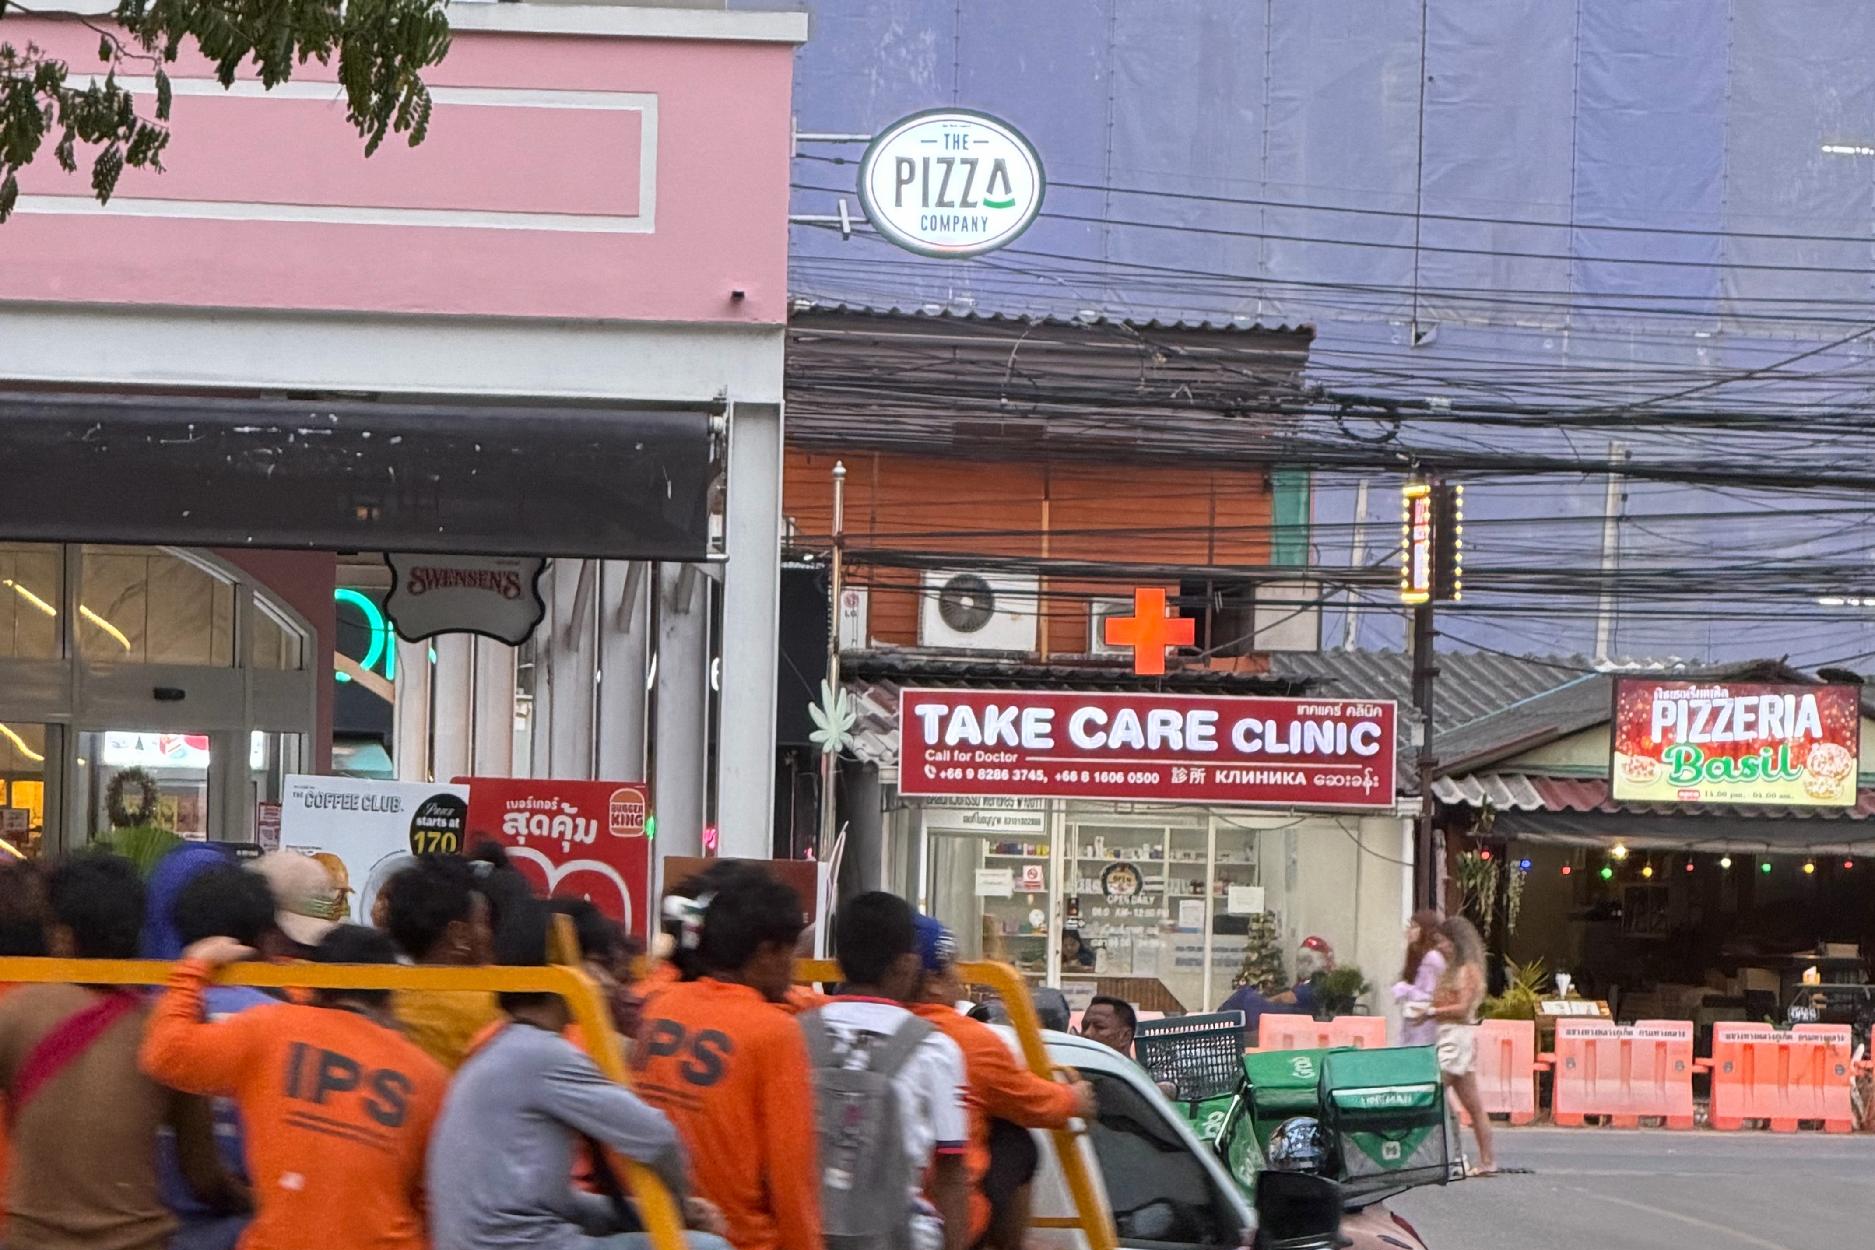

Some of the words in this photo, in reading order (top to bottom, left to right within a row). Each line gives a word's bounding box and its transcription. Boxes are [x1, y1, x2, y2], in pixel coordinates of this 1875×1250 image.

[943, 133, 970, 150] THE
[894, 155, 1016, 209] PIZZA
[920, 214, 988, 232] COMPANY
[406, 566, 521, 600] SWENSEN'S
[1297, 702, 1343, 716] เทคแคร์
[1346, 703, 1383, 718] คลินิก
[1651, 694, 1823, 744] PIZZERIA
[914, 704, 1055, 748] TAKE
[1068, 706, 1219, 751] CARE
[1231, 718, 1382, 756] CLINIC
[924, 749, 951, 762] Call
[953, 750, 972, 763] for
[975, 751, 1018, 763] Doctor
[1661, 742, 1804, 787] Basil
[1127, 772, 1160, 784] 0500
[1171, 767, 1206, 785] 診所
[1215, 769, 1307, 786] КЛИНИКА
[304, 790, 360, 811] COFFEE
[506, 795, 560, 810] เบอร์เกอร์
[611, 804, 643, 814] BURGER
[416, 815, 447, 828] starts
[448, 817, 460, 829] at
[502, 802, 598, 853] สุดคุ้ม
[611, 814, 643, 826] KING
[287, 1041, 416, 1128] IPS
